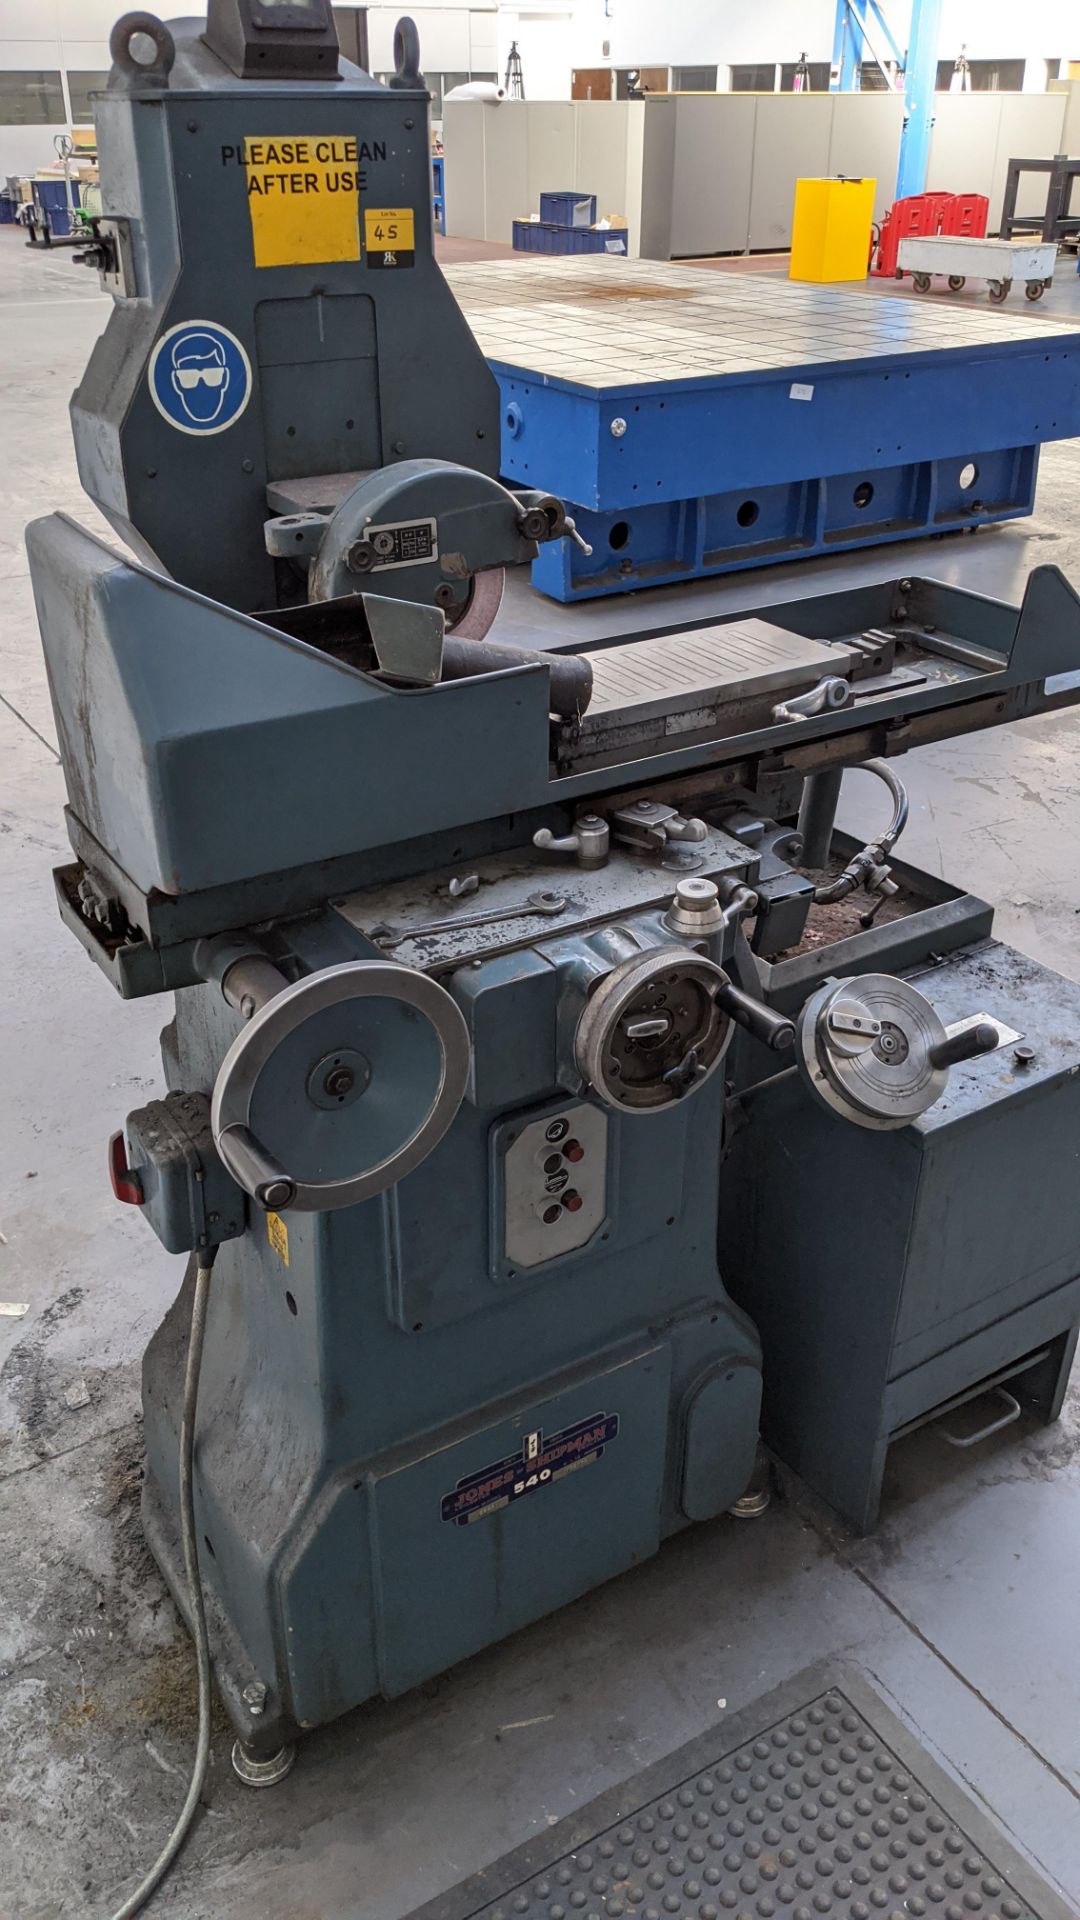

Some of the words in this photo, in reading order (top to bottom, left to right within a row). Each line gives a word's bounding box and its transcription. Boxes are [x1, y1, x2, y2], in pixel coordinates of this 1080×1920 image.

[221, 143, 309, 167] PLEASE
[315, 141, 387, 163] CLEAN
[248, 172, 320, 196] AFTER
[325, 171, 368, 193] USE
[513, 1468, 551, 1494] 540
